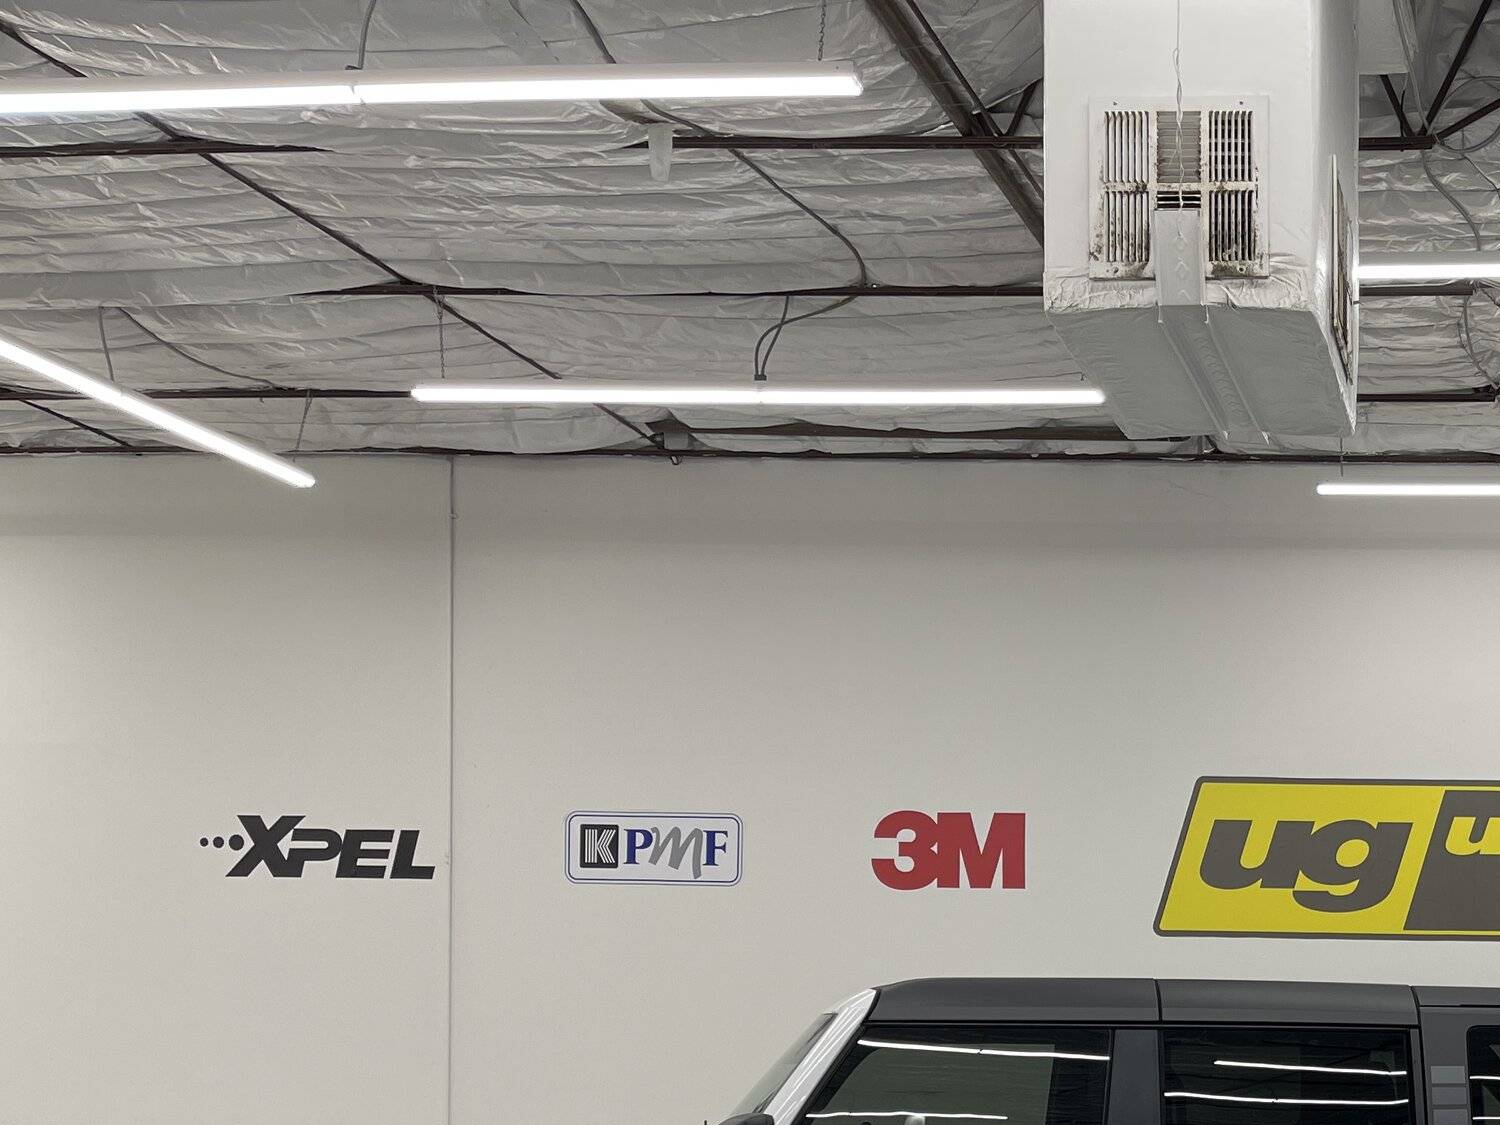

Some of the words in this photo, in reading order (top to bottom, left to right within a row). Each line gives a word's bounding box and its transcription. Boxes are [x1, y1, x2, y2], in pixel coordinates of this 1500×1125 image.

[226, 815, 435, 879] XPEL
[580, 824, 729, 879] KPMF
[872, 811, 1026, 890] 3M
[1200, 819, 1413, 912] ug
